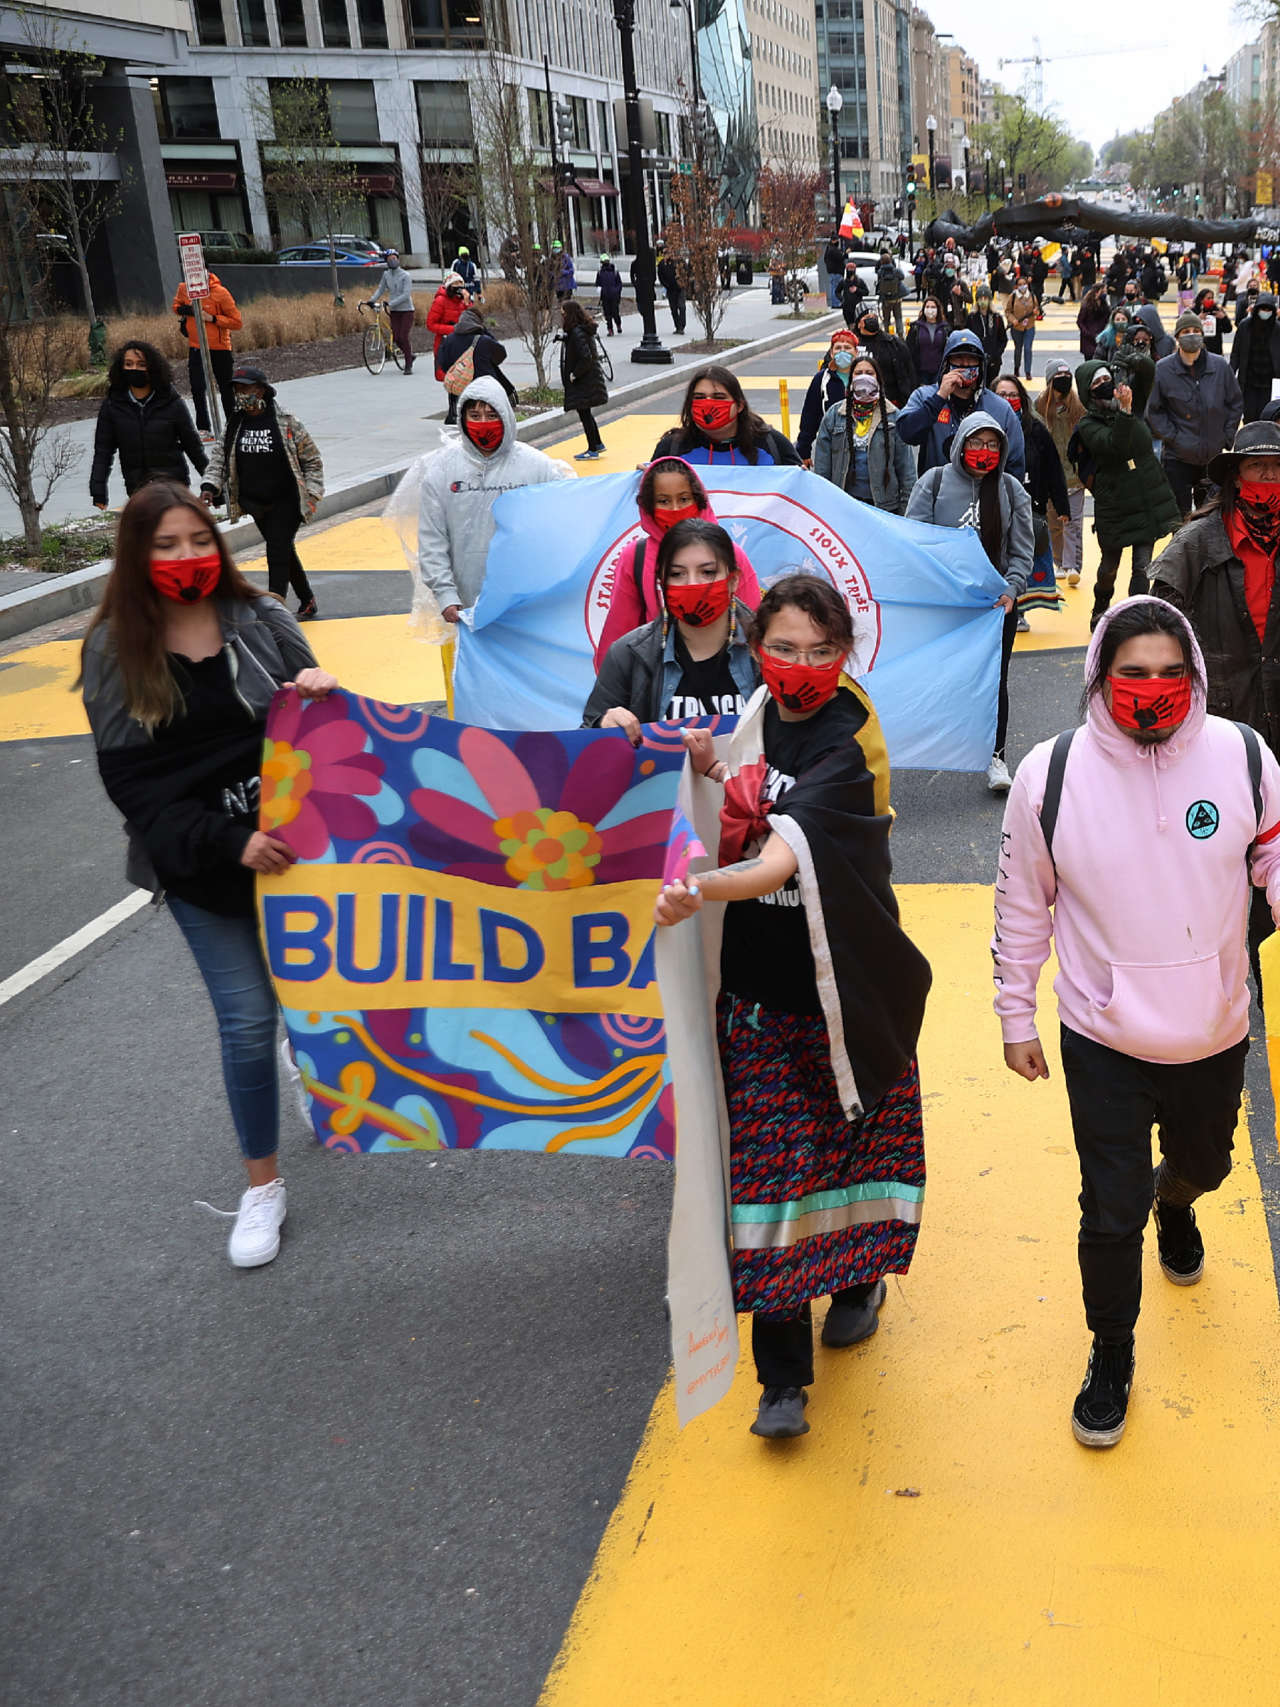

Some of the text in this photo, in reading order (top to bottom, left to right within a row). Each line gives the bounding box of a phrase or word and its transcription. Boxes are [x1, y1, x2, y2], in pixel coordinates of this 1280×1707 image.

[244, 429, 271, 437] STOP
[241, 436, 273, 445] BEING
[241, 444, 274, 454] COPS.
[809, 527, 870, 613] SIOUX TRIBE
[263, 893, 546, 985] BUILD
